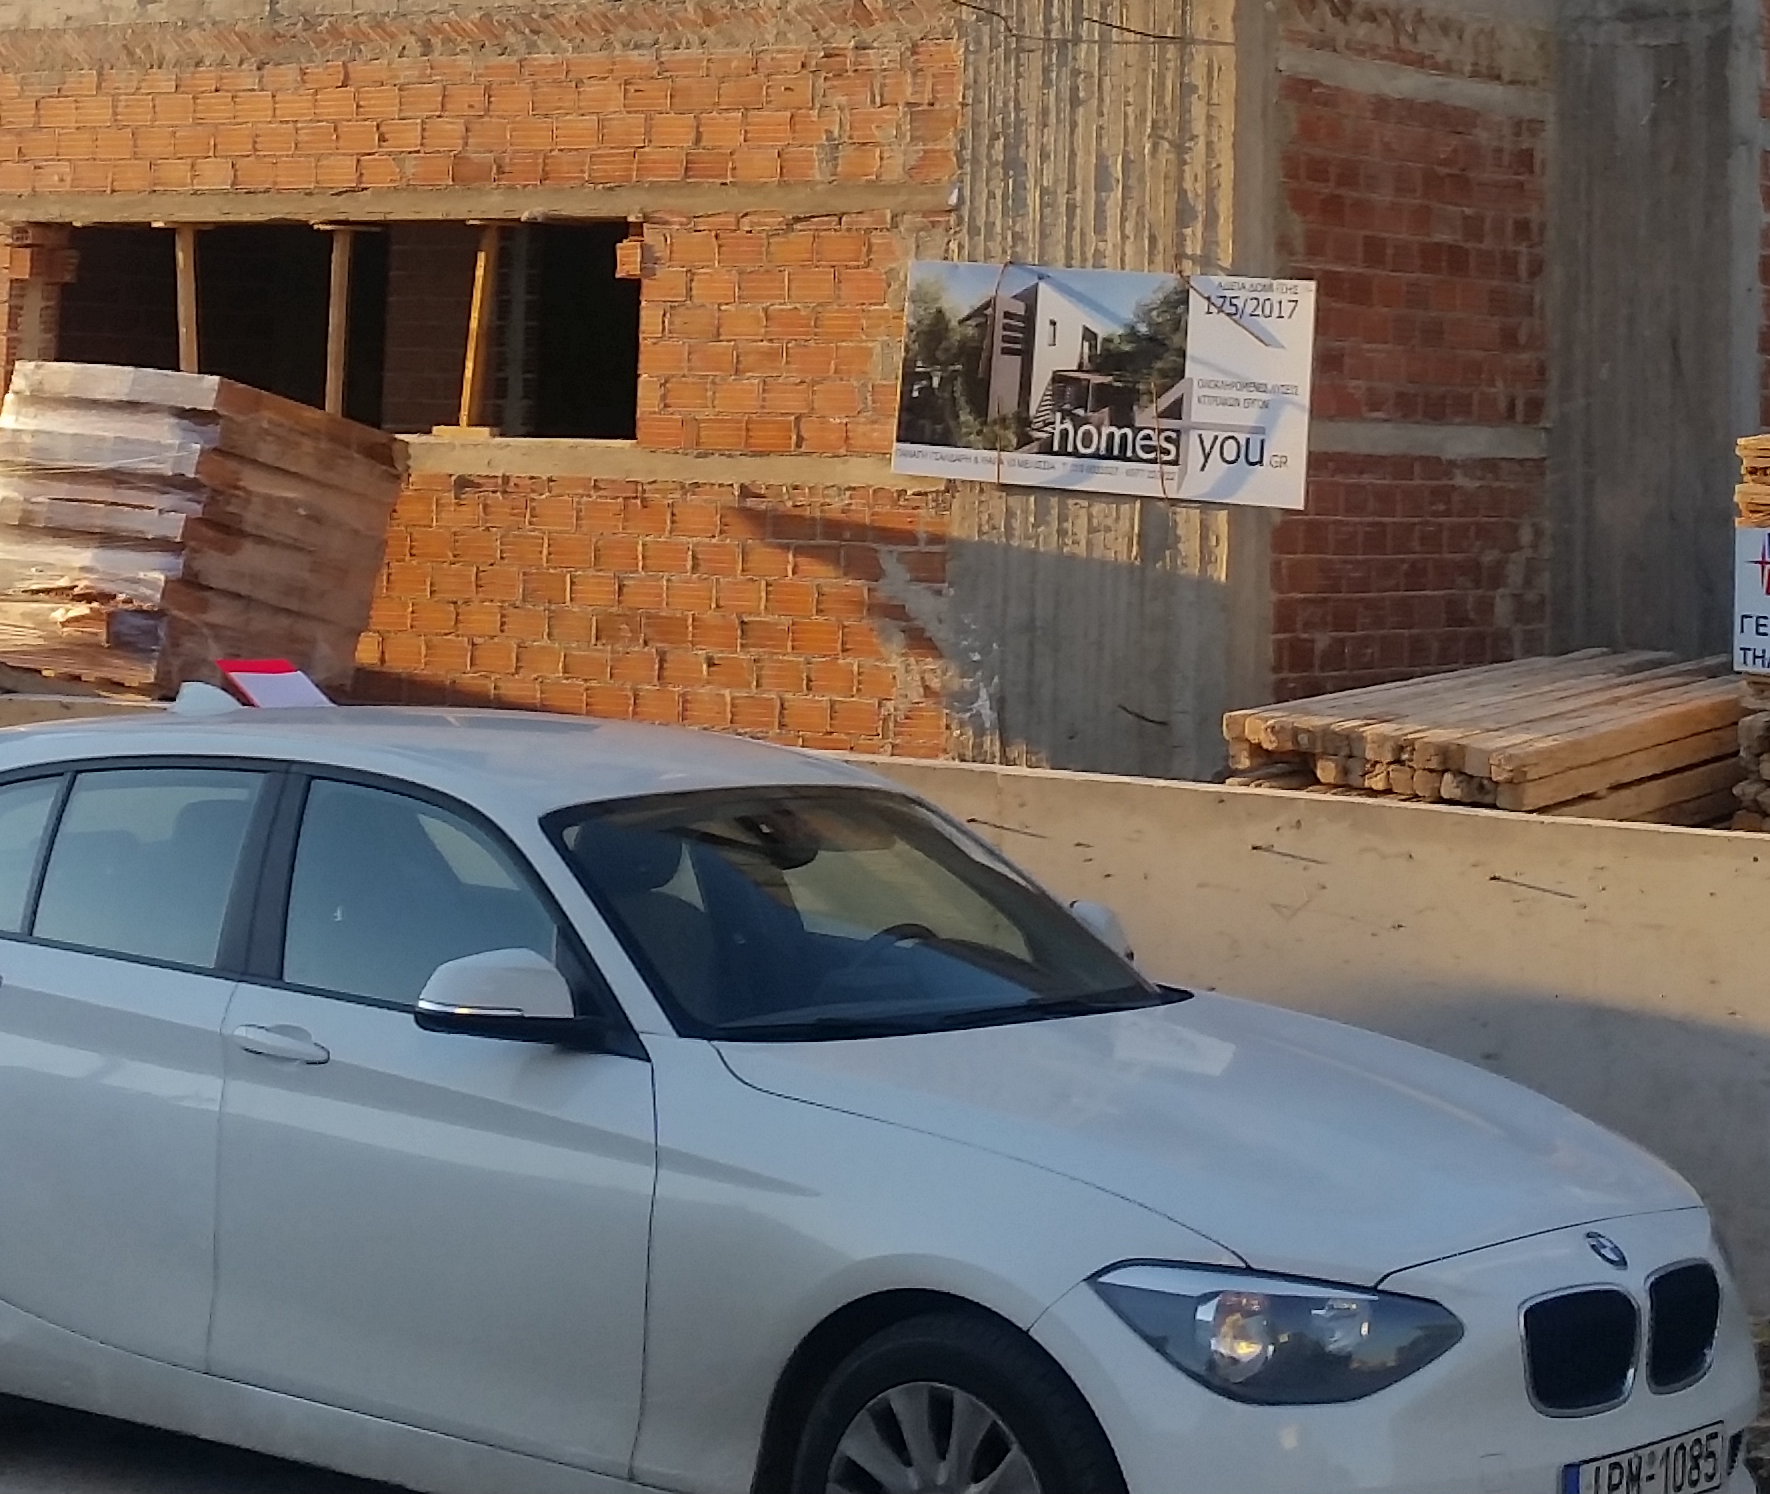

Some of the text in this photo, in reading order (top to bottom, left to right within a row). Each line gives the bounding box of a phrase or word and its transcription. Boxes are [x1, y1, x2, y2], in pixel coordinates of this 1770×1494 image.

[1205, 295, 1299, 320] 175/2017
[1052, 411, 1177, 460] homes
[1198, 433, 1265, 472] you
